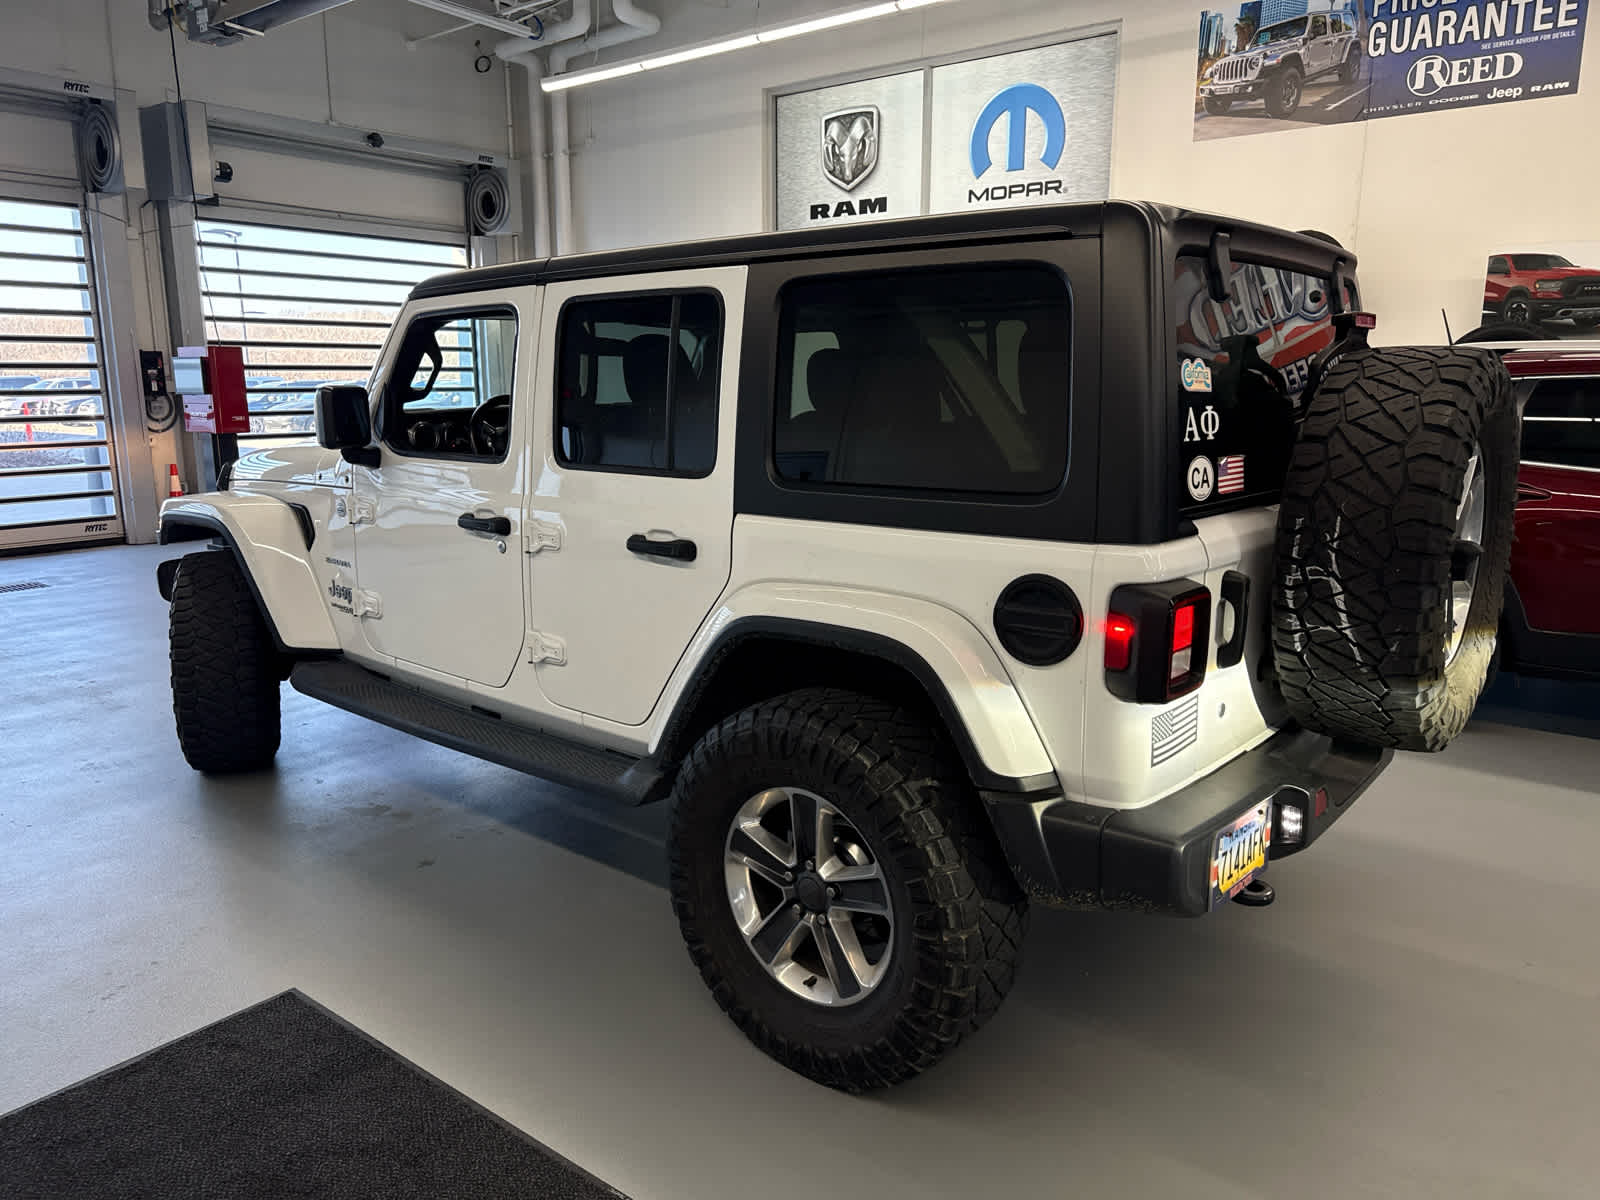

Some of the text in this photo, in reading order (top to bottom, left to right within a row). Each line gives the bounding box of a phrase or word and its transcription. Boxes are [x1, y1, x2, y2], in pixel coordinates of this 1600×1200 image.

[1367, 0, 1578, 57] GUARANTEE
[1492, 40, 1514, 49] SERVICE
[1515, 36, 1539, 45] ADVISOR
[1407, 52, 1523, 96] REED
[1363, 81, 1570, 113] CHRYSLER DODGE Jeep RAM
[968, 179, 1063, 203] MOPAR
[810, 196, 888, 220] RAM
[1192, 467, 1210, 489] CA
[85, 523, 108, 533] RYTEC
